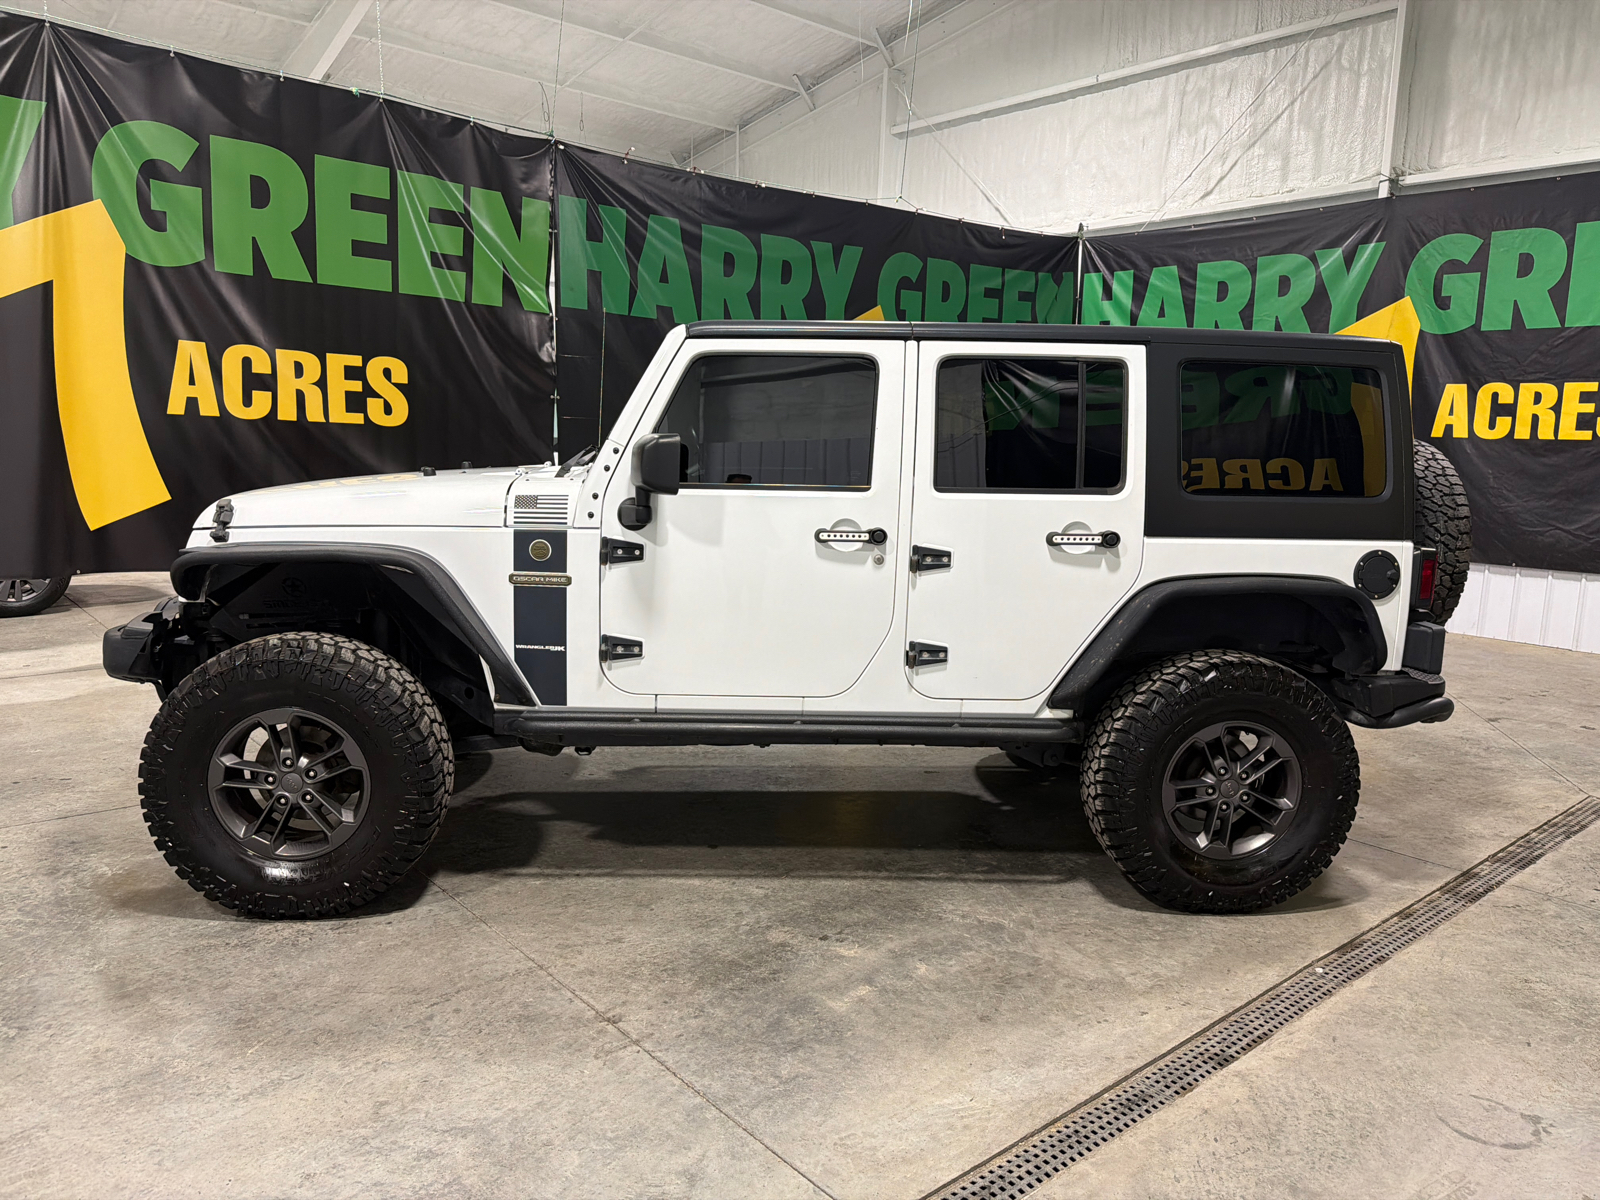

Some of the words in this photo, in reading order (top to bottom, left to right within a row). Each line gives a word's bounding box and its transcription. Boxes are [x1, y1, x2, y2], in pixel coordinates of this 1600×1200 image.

[92, 120, 550, 313] GREEN
[559, 195, 862, 322] HARRY
[1081, 242, 1386, 334] HARRY
[168, 340, 408, 427] ACRES
[1431, 382, 1600, 440] ACRE
